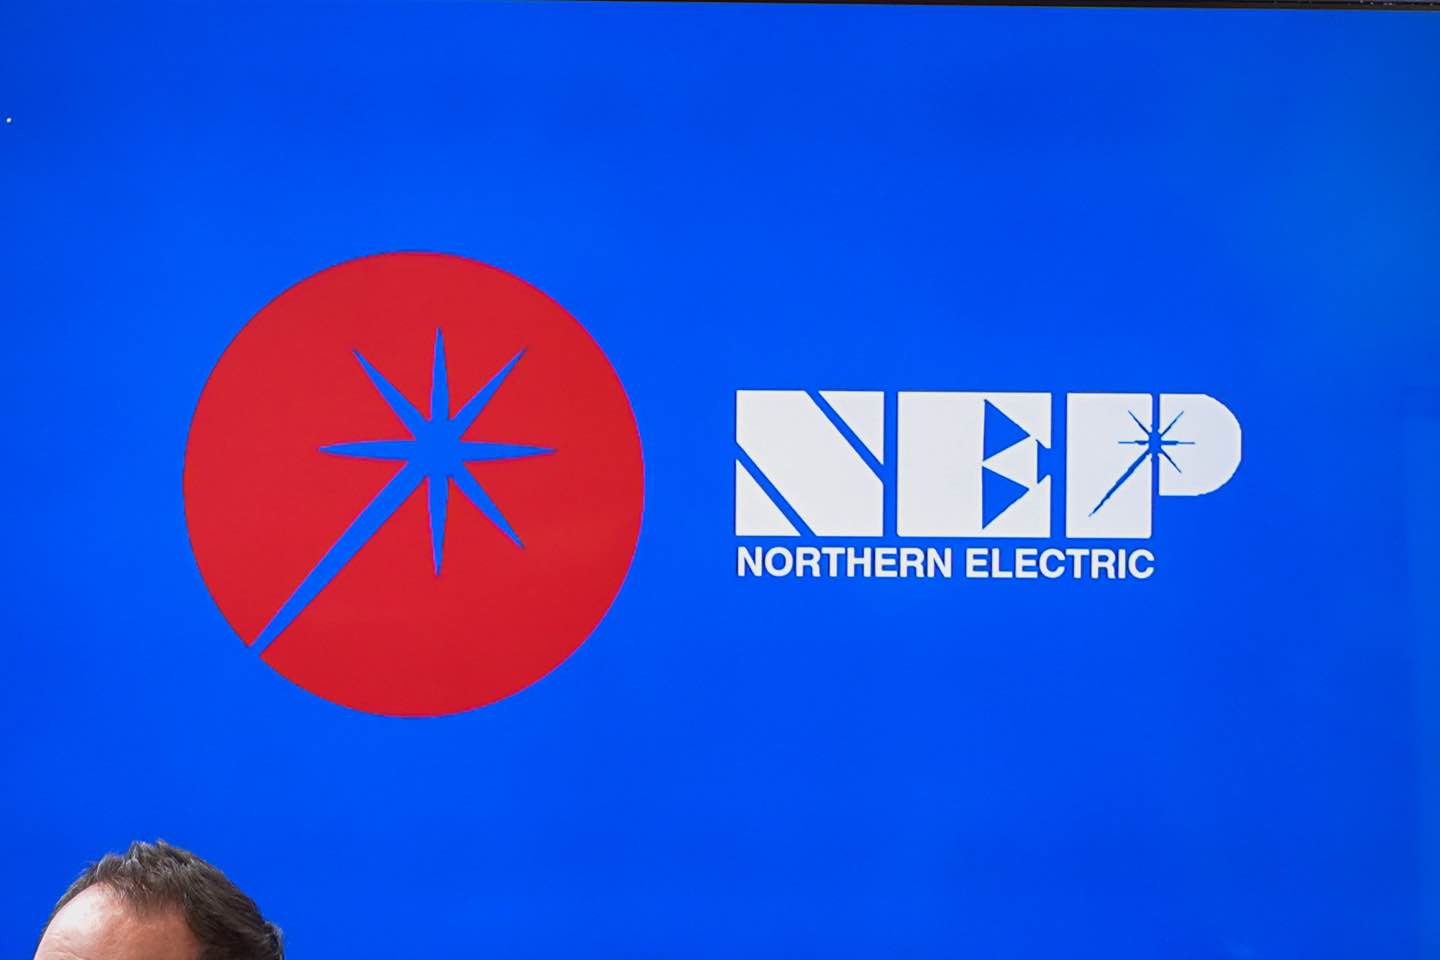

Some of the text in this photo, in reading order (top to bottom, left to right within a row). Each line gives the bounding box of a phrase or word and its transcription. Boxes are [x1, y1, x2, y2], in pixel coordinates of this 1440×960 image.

[735, 390, 1242, 538] NEP
[737, 546, 1155, 579] NORTHERN ELECTRIC
